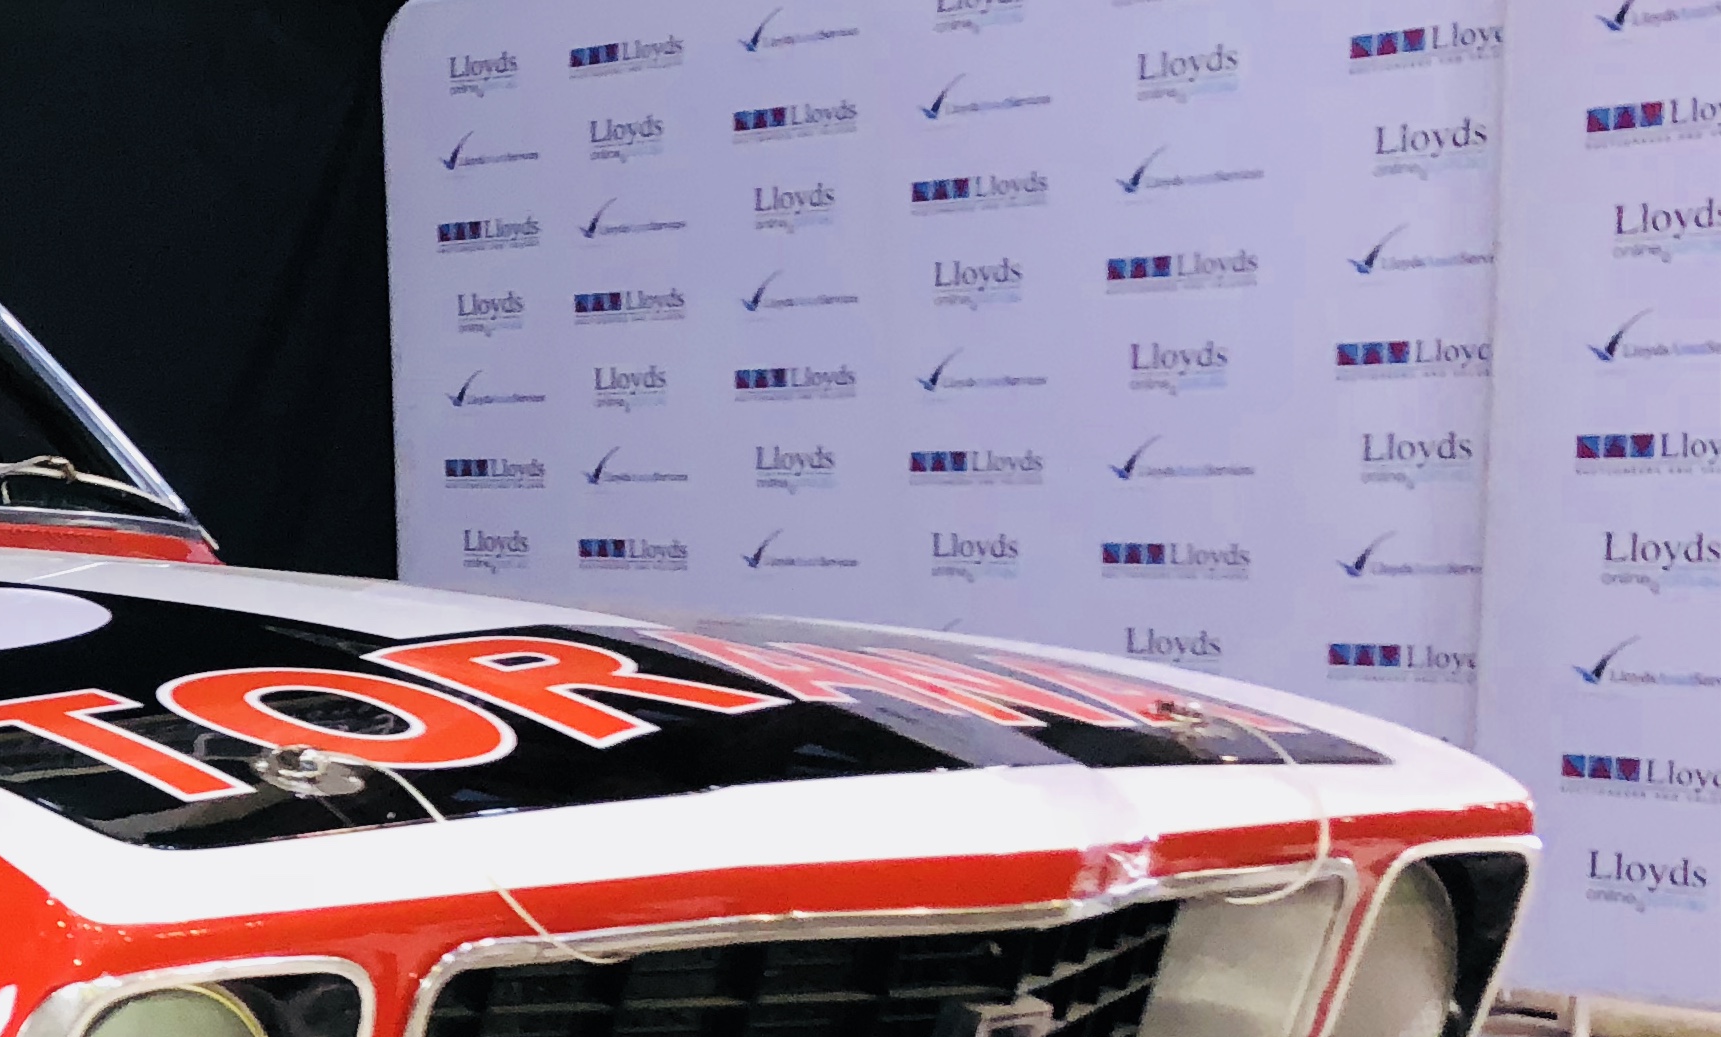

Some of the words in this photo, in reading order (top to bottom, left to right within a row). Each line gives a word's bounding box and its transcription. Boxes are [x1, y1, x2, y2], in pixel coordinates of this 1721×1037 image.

[448, 52, 518, 82] Lloyds
[1137, 44, 1239, 83] Lloyds
[790, 100, 857, 130] Lloyds
[1669, 97, 1721, 127] Llo
[589, 115, 663, 150] Lloyds
[1375, 117, 1488, 158] Lloyds
[753, 183, 835, 215] Lloyds
[974, 171, 1048, 202] Lloyds
[1614, 198, 1721, 240] Lloyd
[934, 258, 1023, 291] Lloyds
[1177, 249, 1258, 280] Lloyds
[457, 291, 524, 320] Lloyds
[1129, 341, 1229, 375] Lloyds
[594, 365, 667, 393] Lloyds
[755, 445, 835, 473] Lloyds
[968, 450, 1044, 475] Lloyds
[1363, 431, 1474, 467] Lloyds
[463, 530, 530, 557] Lloyds
[931, 532, 1019, 563] Lloyds
[1170, 543, 1251, 571] Lloyds
[1604, 531, 1721, 574] Lloyds
[1125, 627, 1223, 661] Lloyds
[1588, 850, 1708, 890] Lloyds
